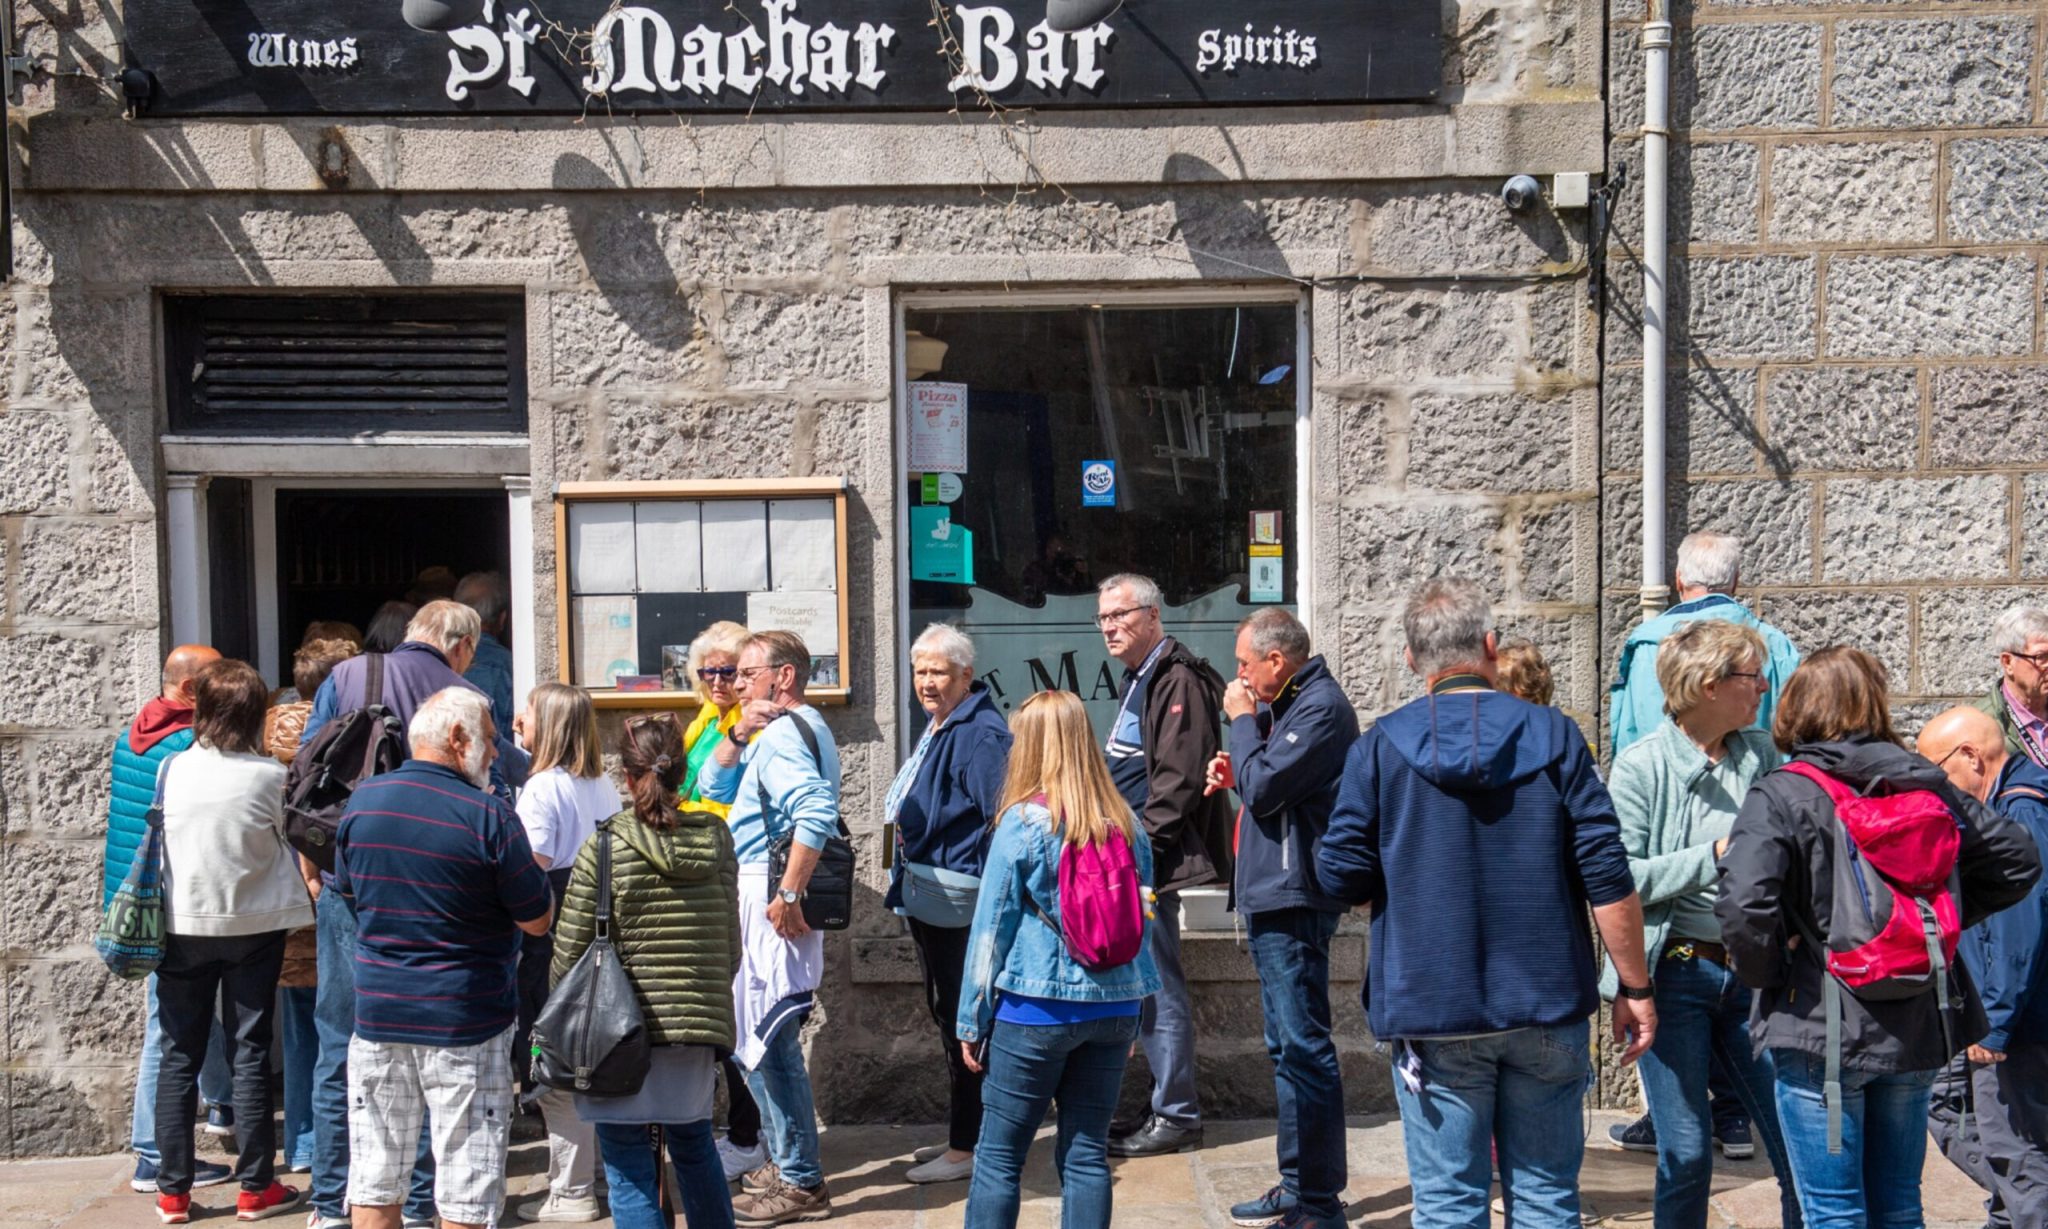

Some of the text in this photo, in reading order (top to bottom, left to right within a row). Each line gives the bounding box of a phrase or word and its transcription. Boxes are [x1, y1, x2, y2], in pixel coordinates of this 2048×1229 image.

[248, 32, 359, 69] Wines
[446, 0, 1115, 100] St Machar Bar
[1196, 22, 1318, 72] Spirits
[917, 390, 958, 402] Pizza
[769, 606, 818, 616] Postcards
